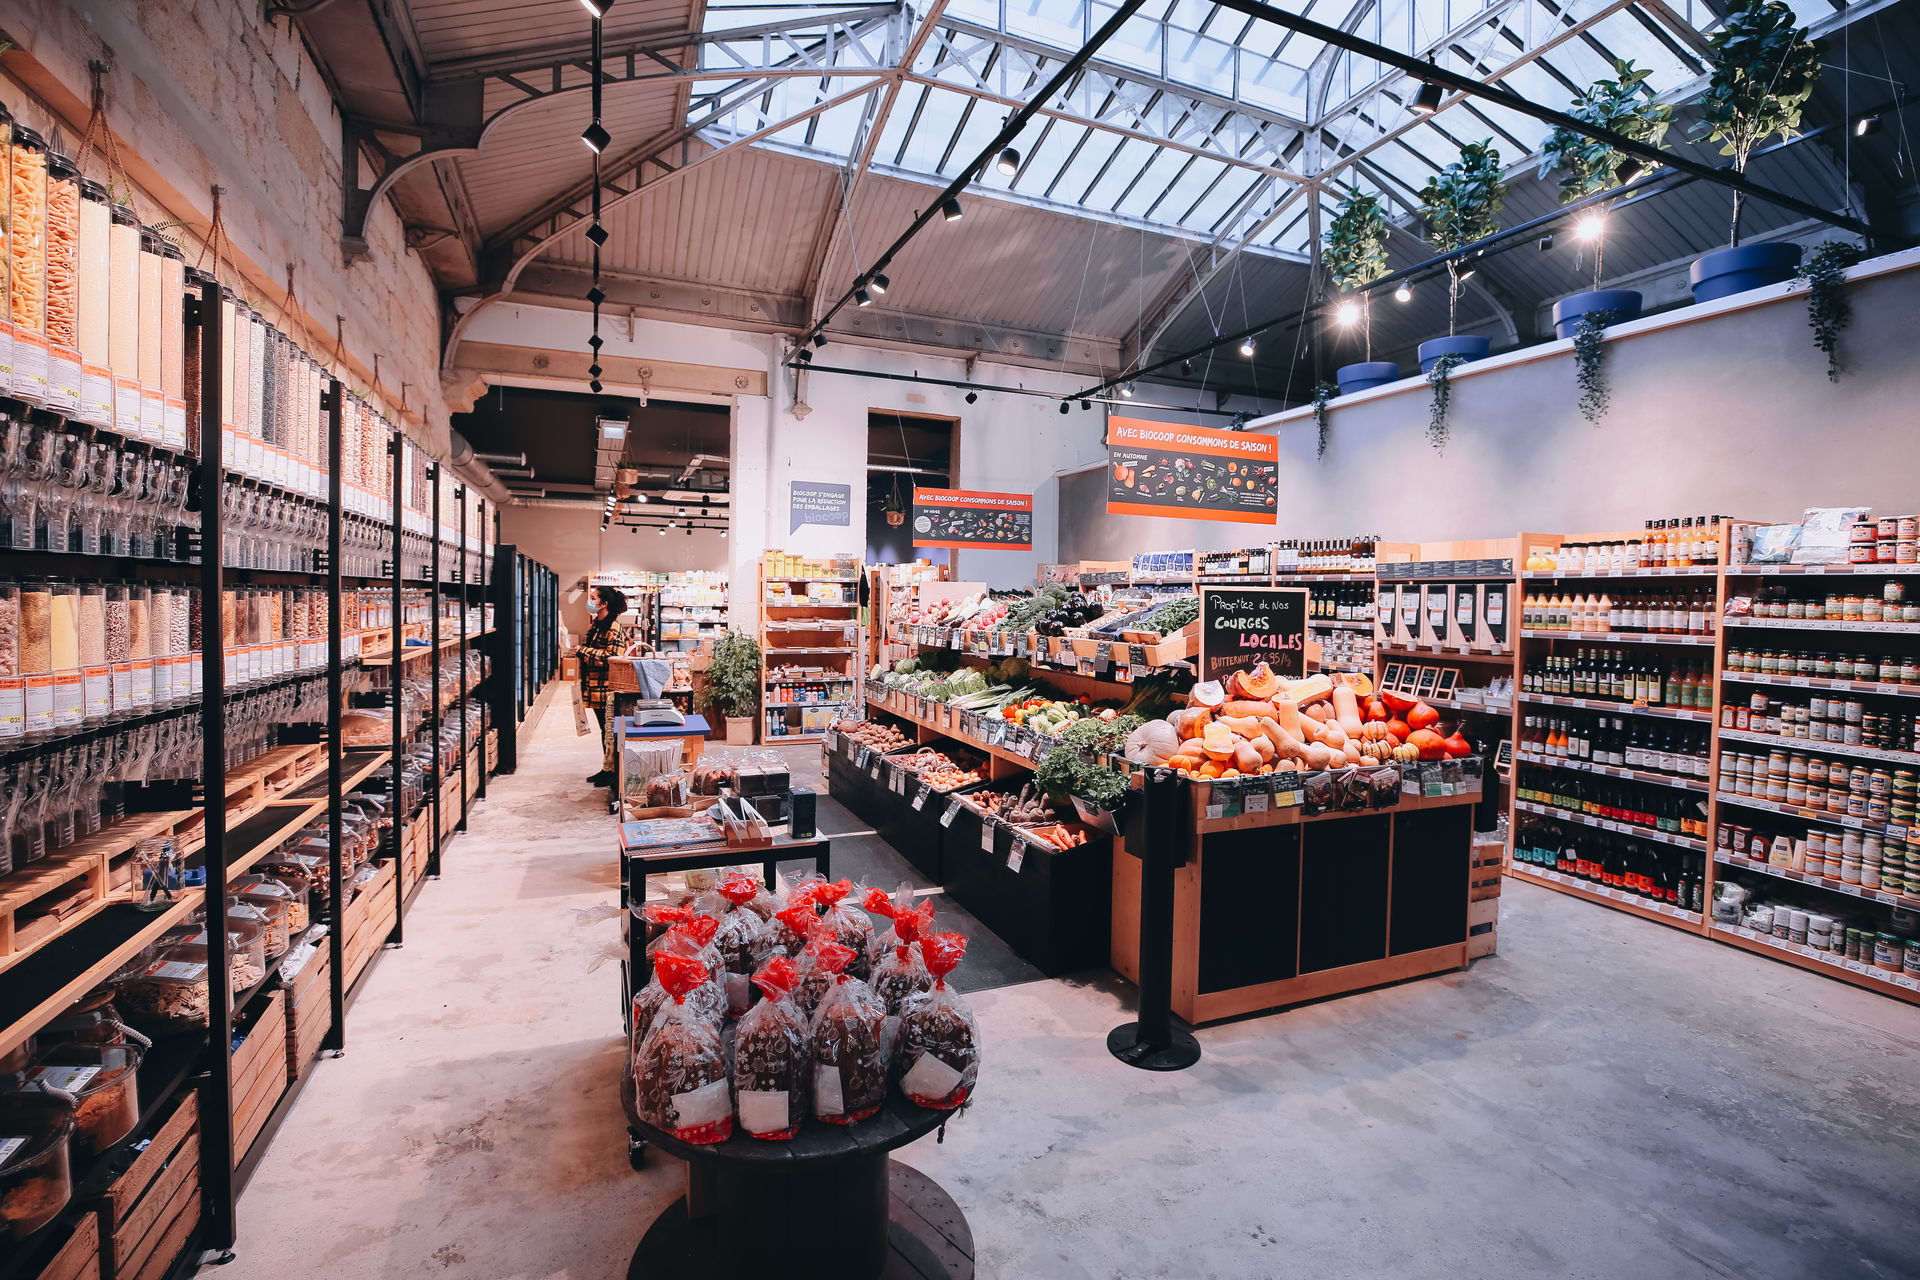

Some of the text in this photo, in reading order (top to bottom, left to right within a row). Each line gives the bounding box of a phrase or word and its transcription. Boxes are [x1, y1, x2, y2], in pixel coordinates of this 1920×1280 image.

[1116, 426, 1138, 438] AVEC
[1140, 429, 1174, 442] BIOCOOP
[1176, 434, 1228, 449] CONSOMMONS
[1230, 440, 1239, 450] DE
[1240, 441, 1268, 453] SAISON
[1259, 600, 1269, 610] de
[1214, 616, 1270, 630] COURGES
[1240, 633, 1302, 651] LOCALES
[1211, 654, 1249, 670] BUTTERNUT
